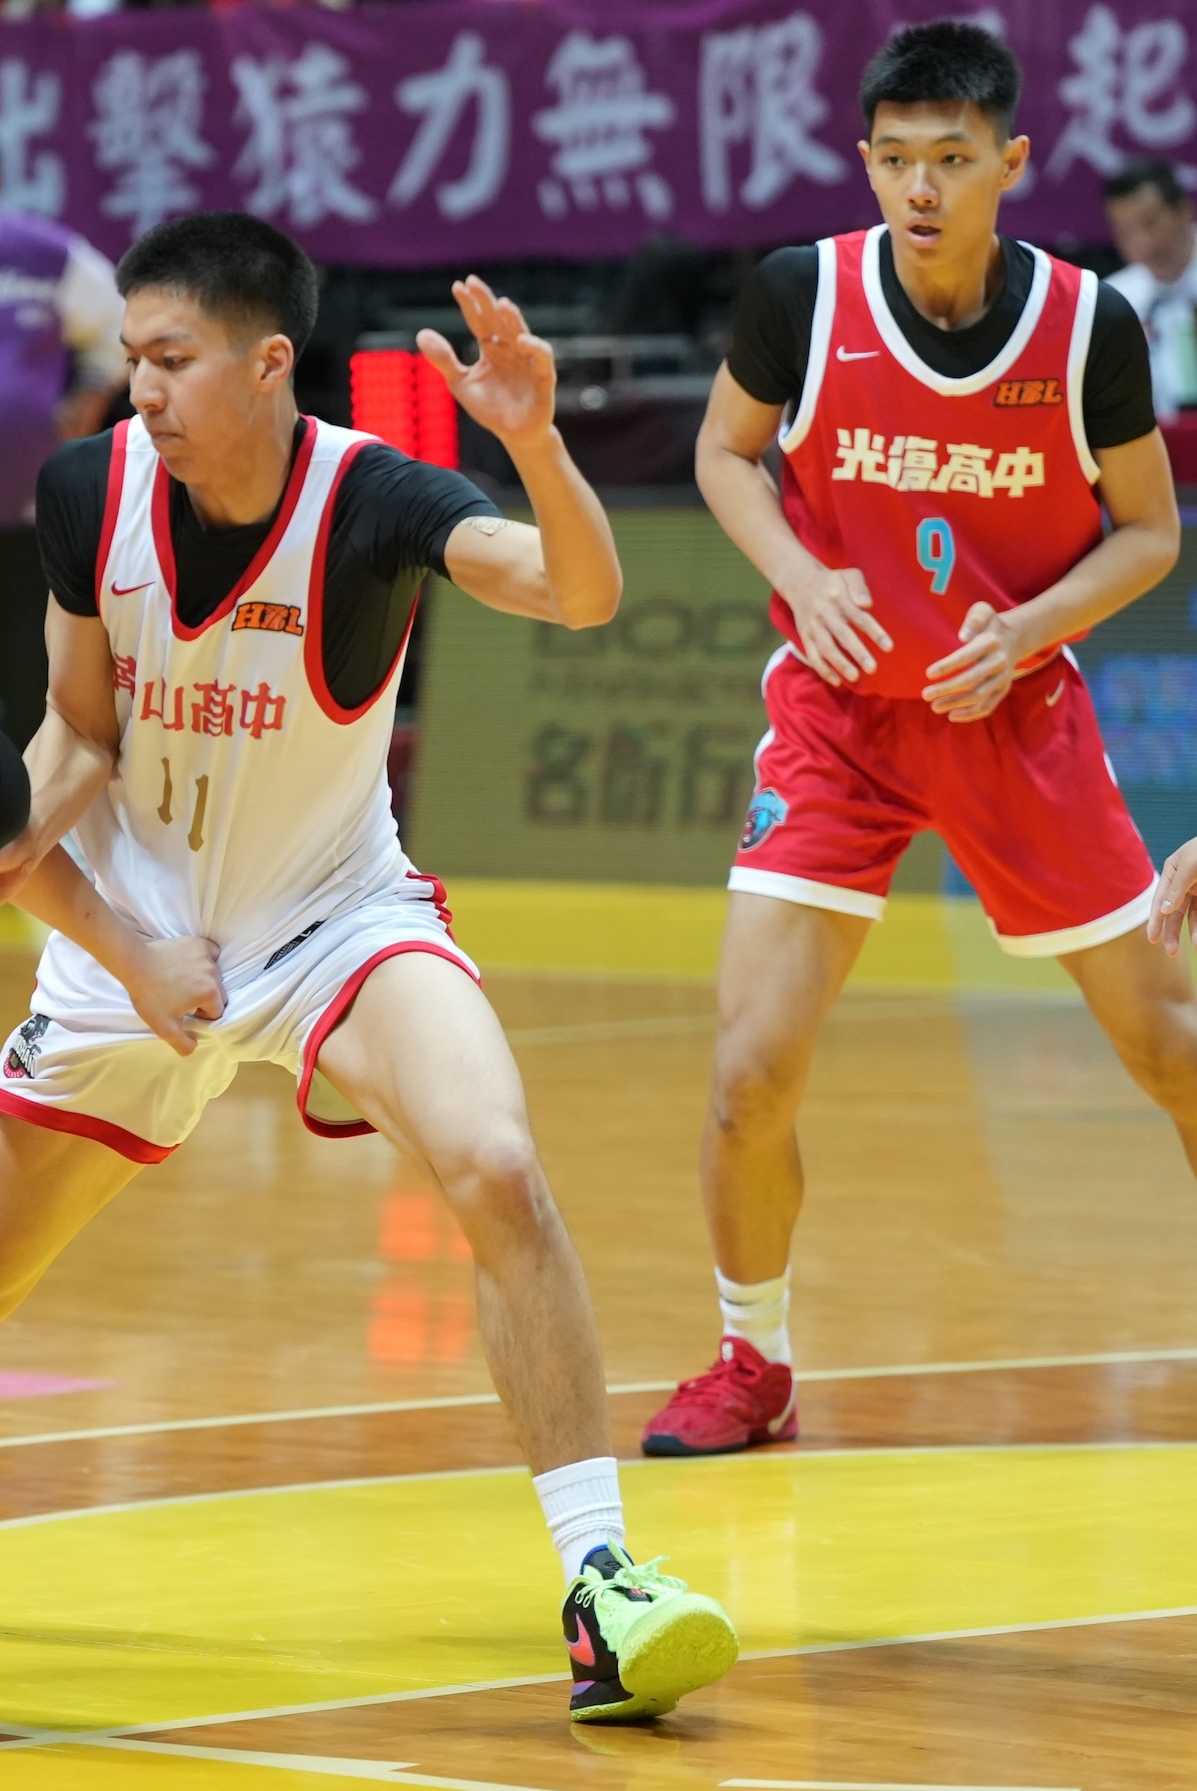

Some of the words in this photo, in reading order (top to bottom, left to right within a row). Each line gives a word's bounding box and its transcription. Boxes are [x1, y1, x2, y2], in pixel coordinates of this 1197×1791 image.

[994, 379, 1064, 408] HBL
[831, 427, 1046, 498] 光復高中
[915, 517, 956, 596] 9
[231, 601, 304, 637] HBL
[157, 757, 209, 852] 11
